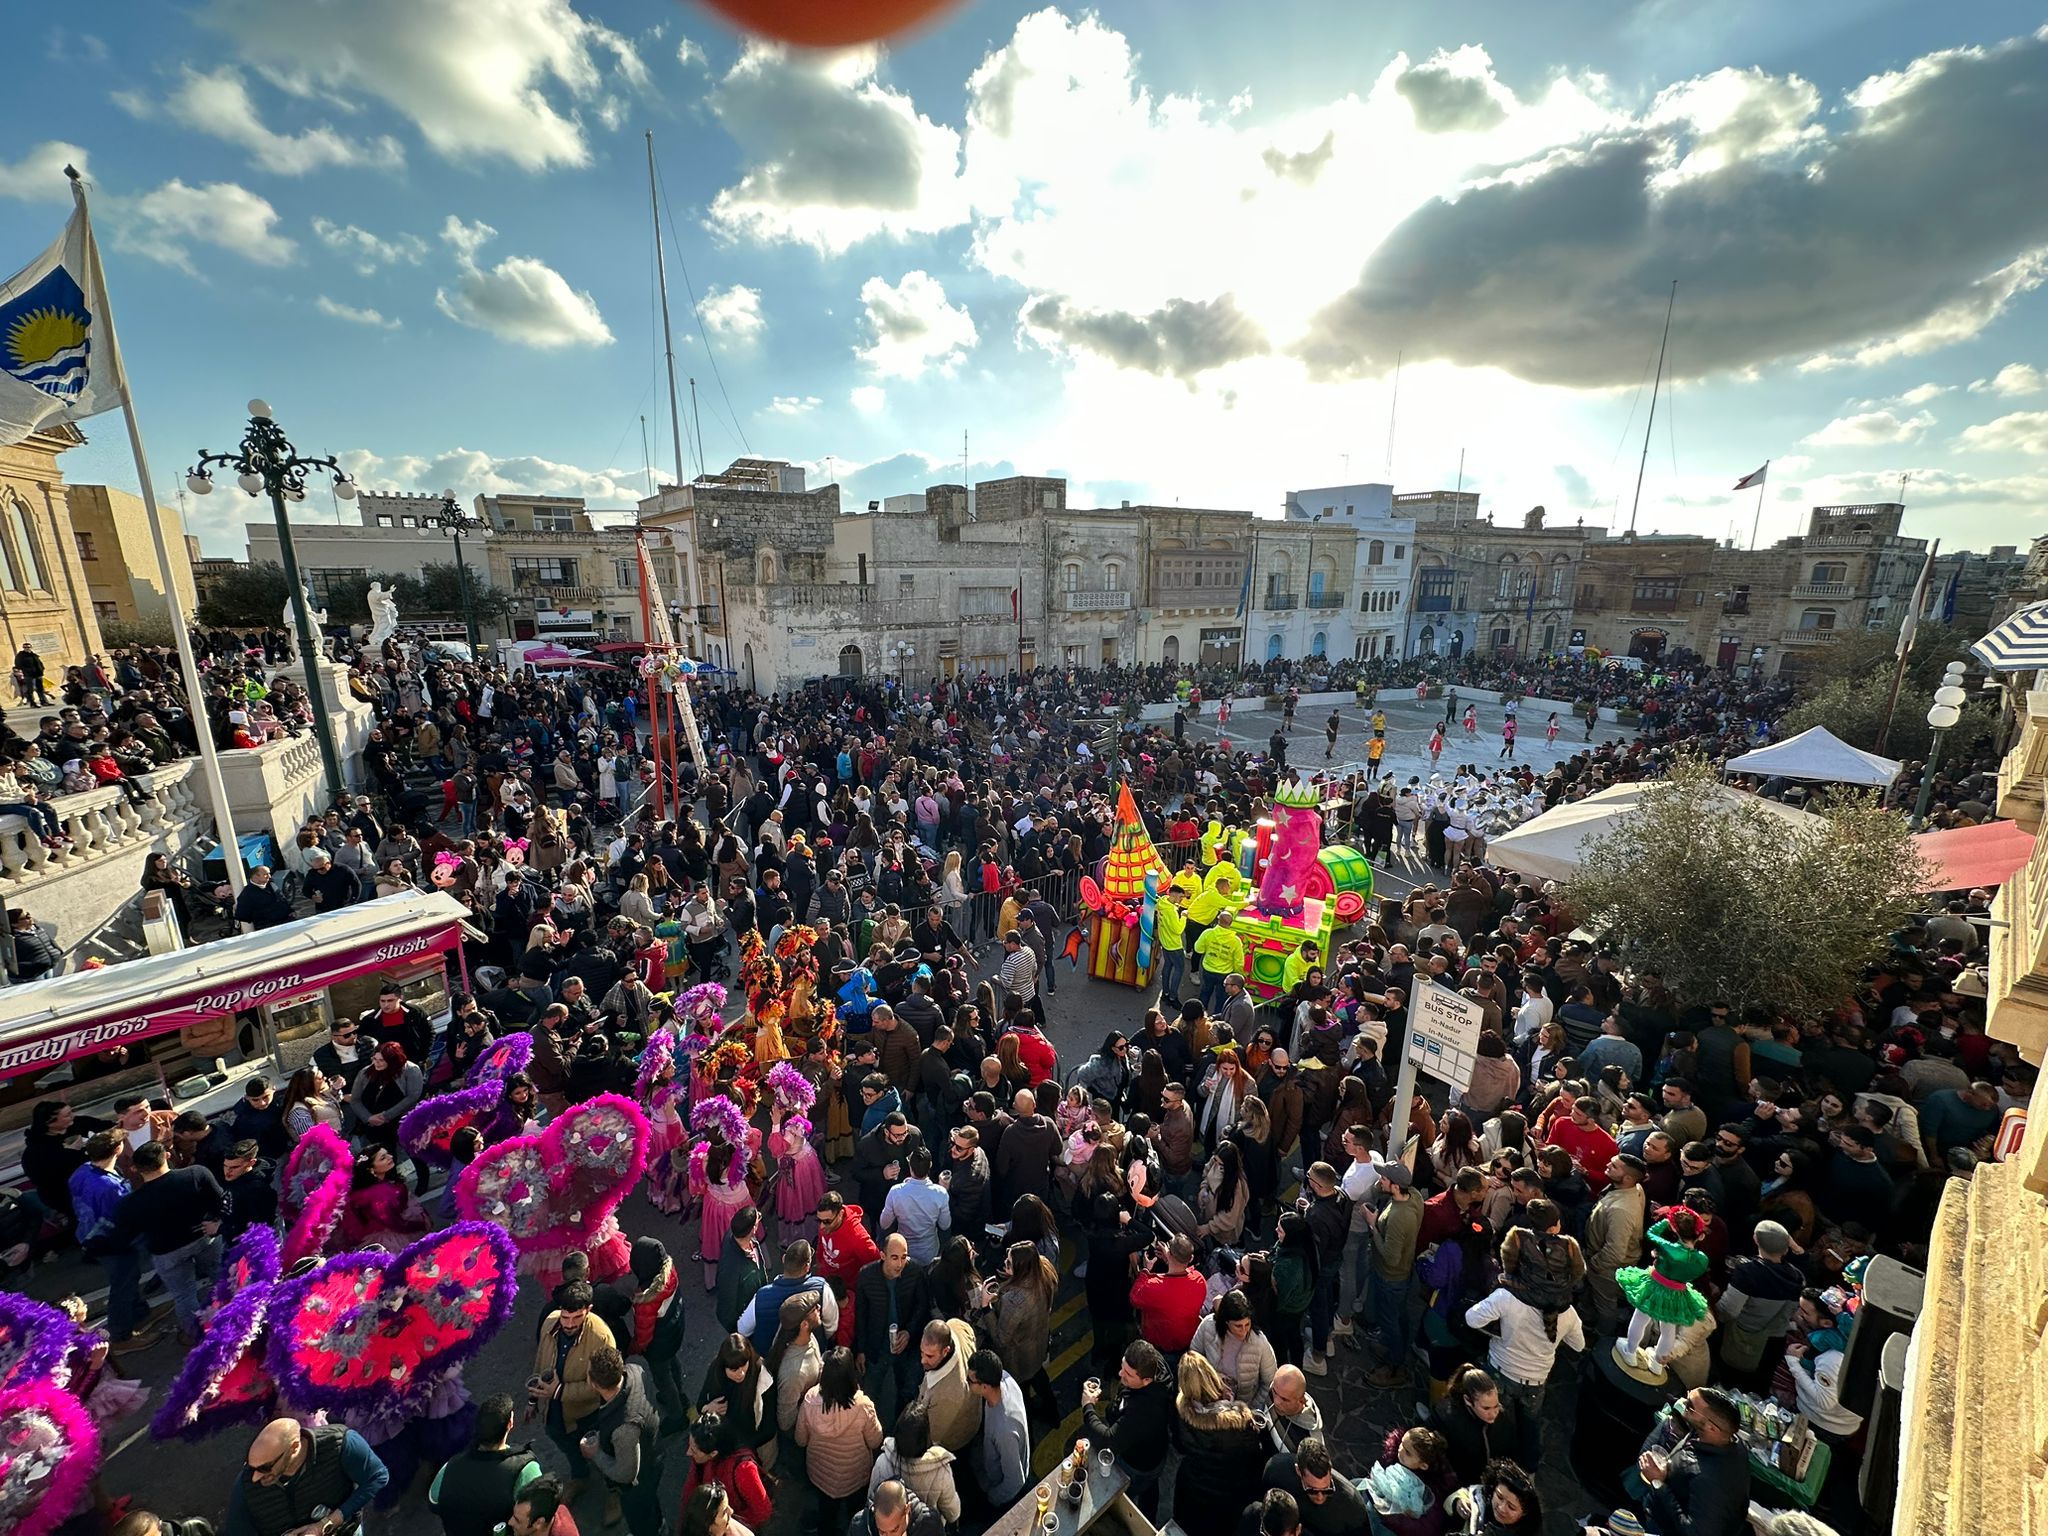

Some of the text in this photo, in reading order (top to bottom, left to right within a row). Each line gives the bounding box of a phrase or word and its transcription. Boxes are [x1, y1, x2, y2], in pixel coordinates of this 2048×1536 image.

[375, 936, 428, 963] Slush
[195, 974, 303, 1014] Pop Corn
[1424, 1001, 1473, 1026] BUS STOP
[1430, 1017, 1461, 1035] In-Nadur
[77, 1016, 149, 1048] Floss
[1428, 1027, 1460, 1046] In-Nadur
